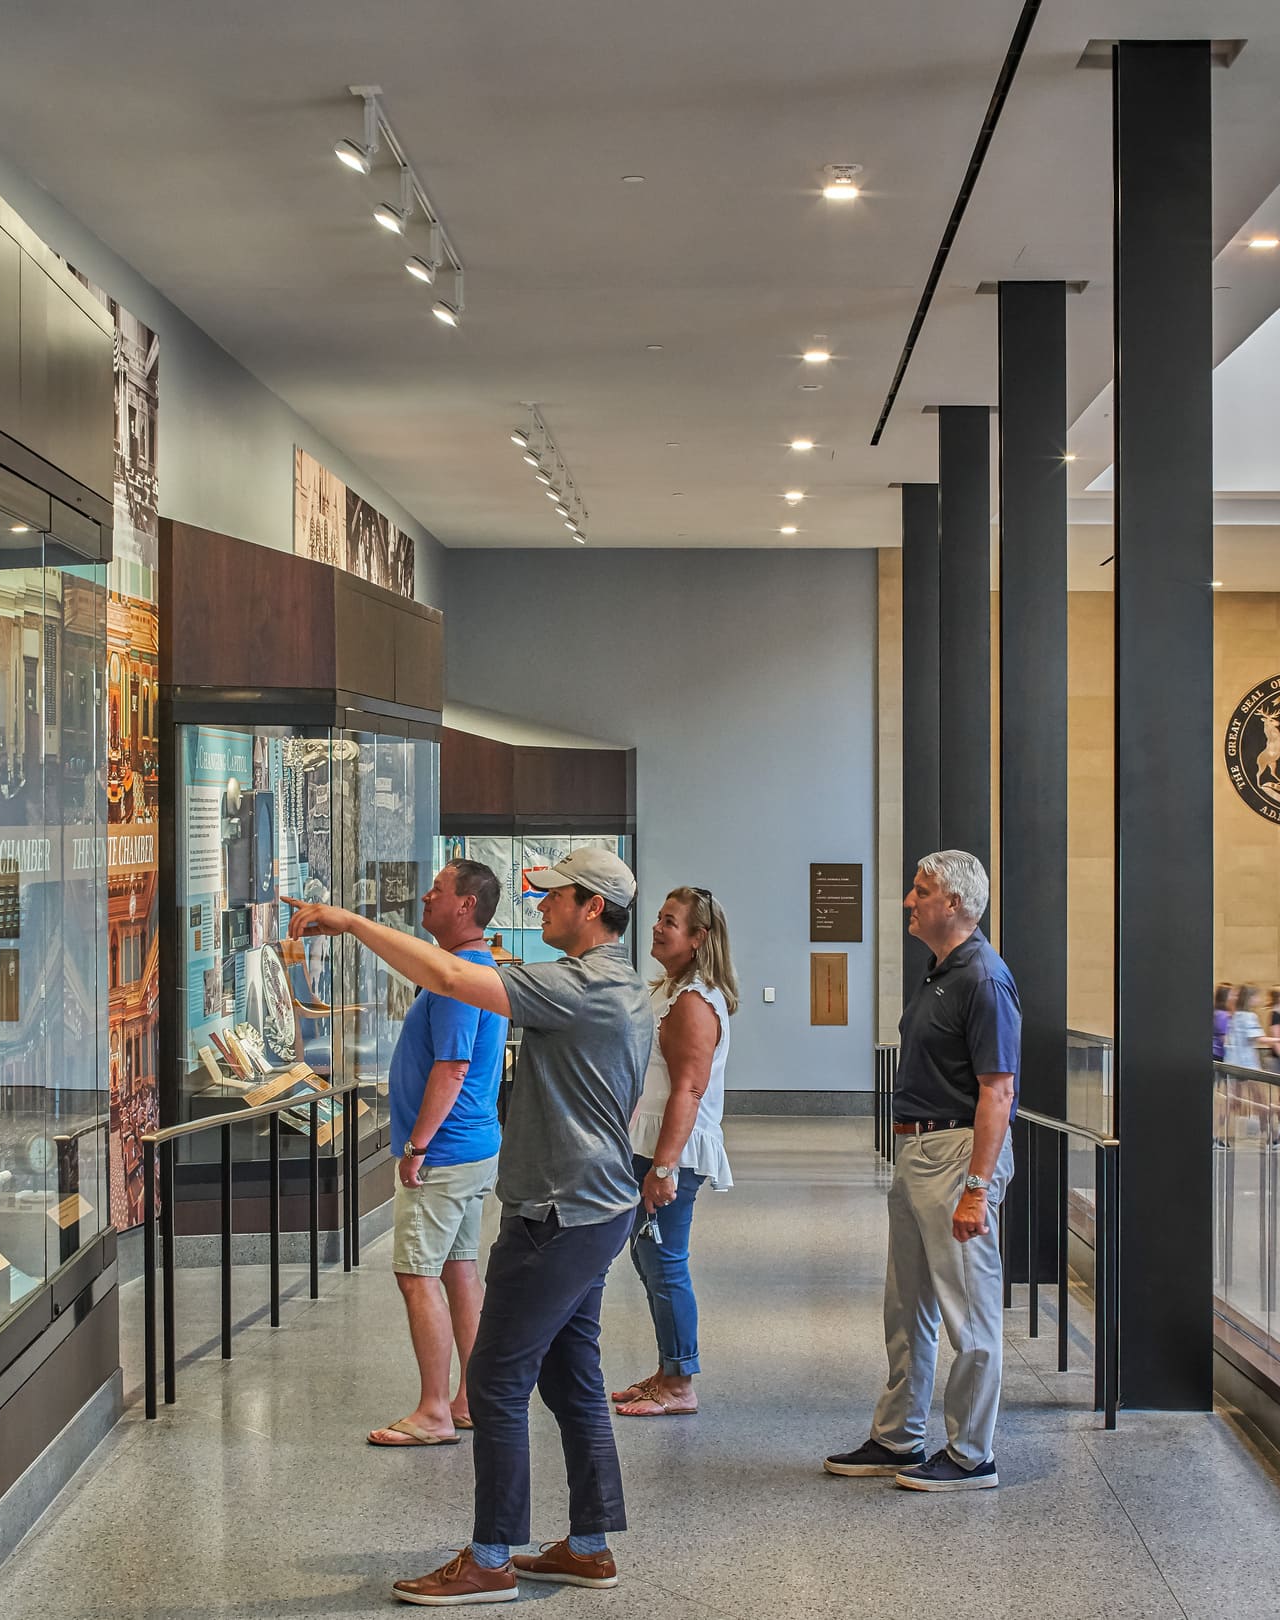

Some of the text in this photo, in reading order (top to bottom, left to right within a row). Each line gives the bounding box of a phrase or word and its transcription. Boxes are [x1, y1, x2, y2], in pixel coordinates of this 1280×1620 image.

[1240, 690, 1265, 714] SEAL
[1227, 718, 1243, 757] GREAT
[1230, 765, 1247, 790] THE
[0, 838, 51, 874] CHAMBER
[72, 837, 90, 870] THE
[90, 835, 118, 869] SENTE
[119, 834, 154, 865] CHAMBER
